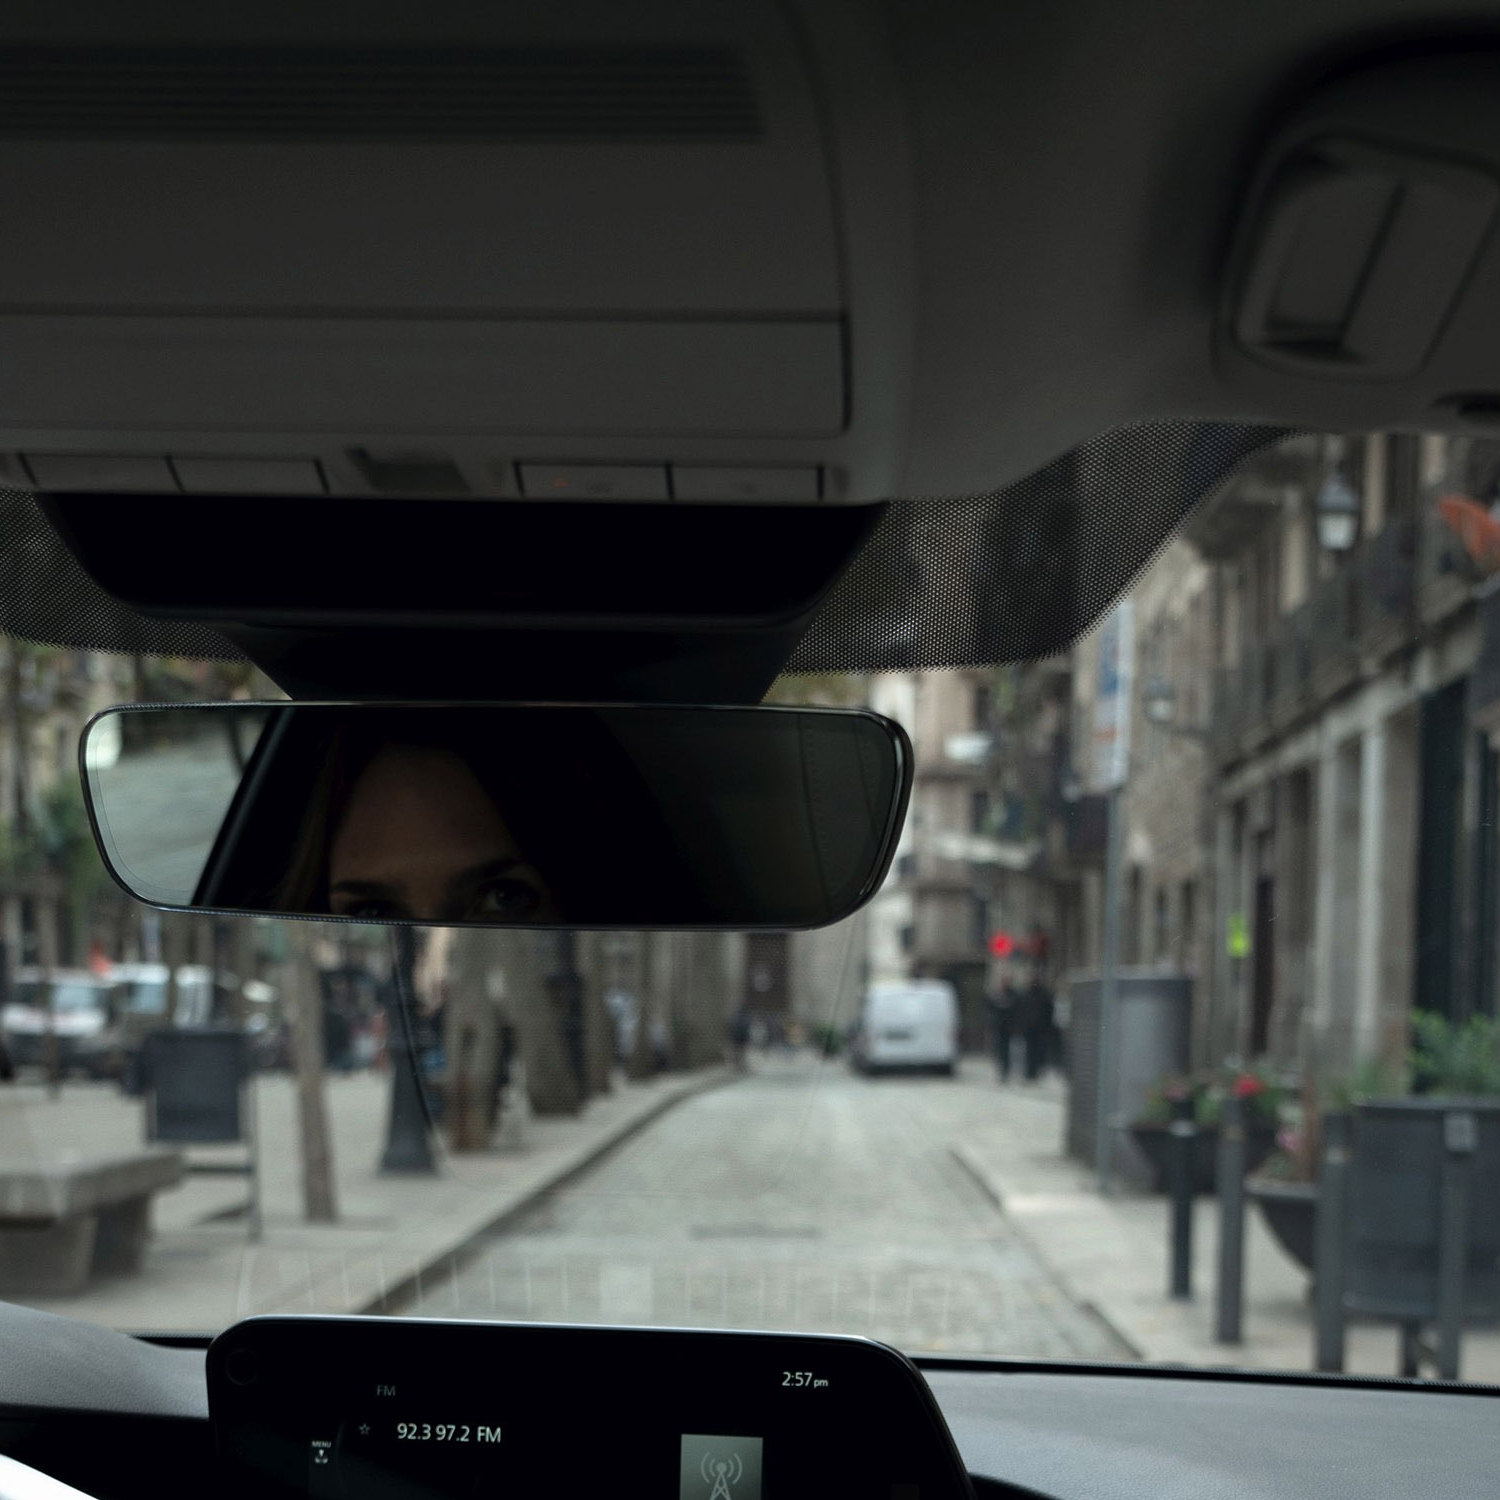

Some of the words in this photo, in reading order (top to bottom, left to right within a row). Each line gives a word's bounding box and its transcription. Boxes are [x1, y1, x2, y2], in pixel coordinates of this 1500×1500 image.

[375, 1384, 396, 1397] FM
[396, 1421, 432, 1441] 92.3
[435, 1423, 471, 1443] 97.2
[476, 1425, 502, 1443] FM
[310, 1439, 333, 1449] MENU
